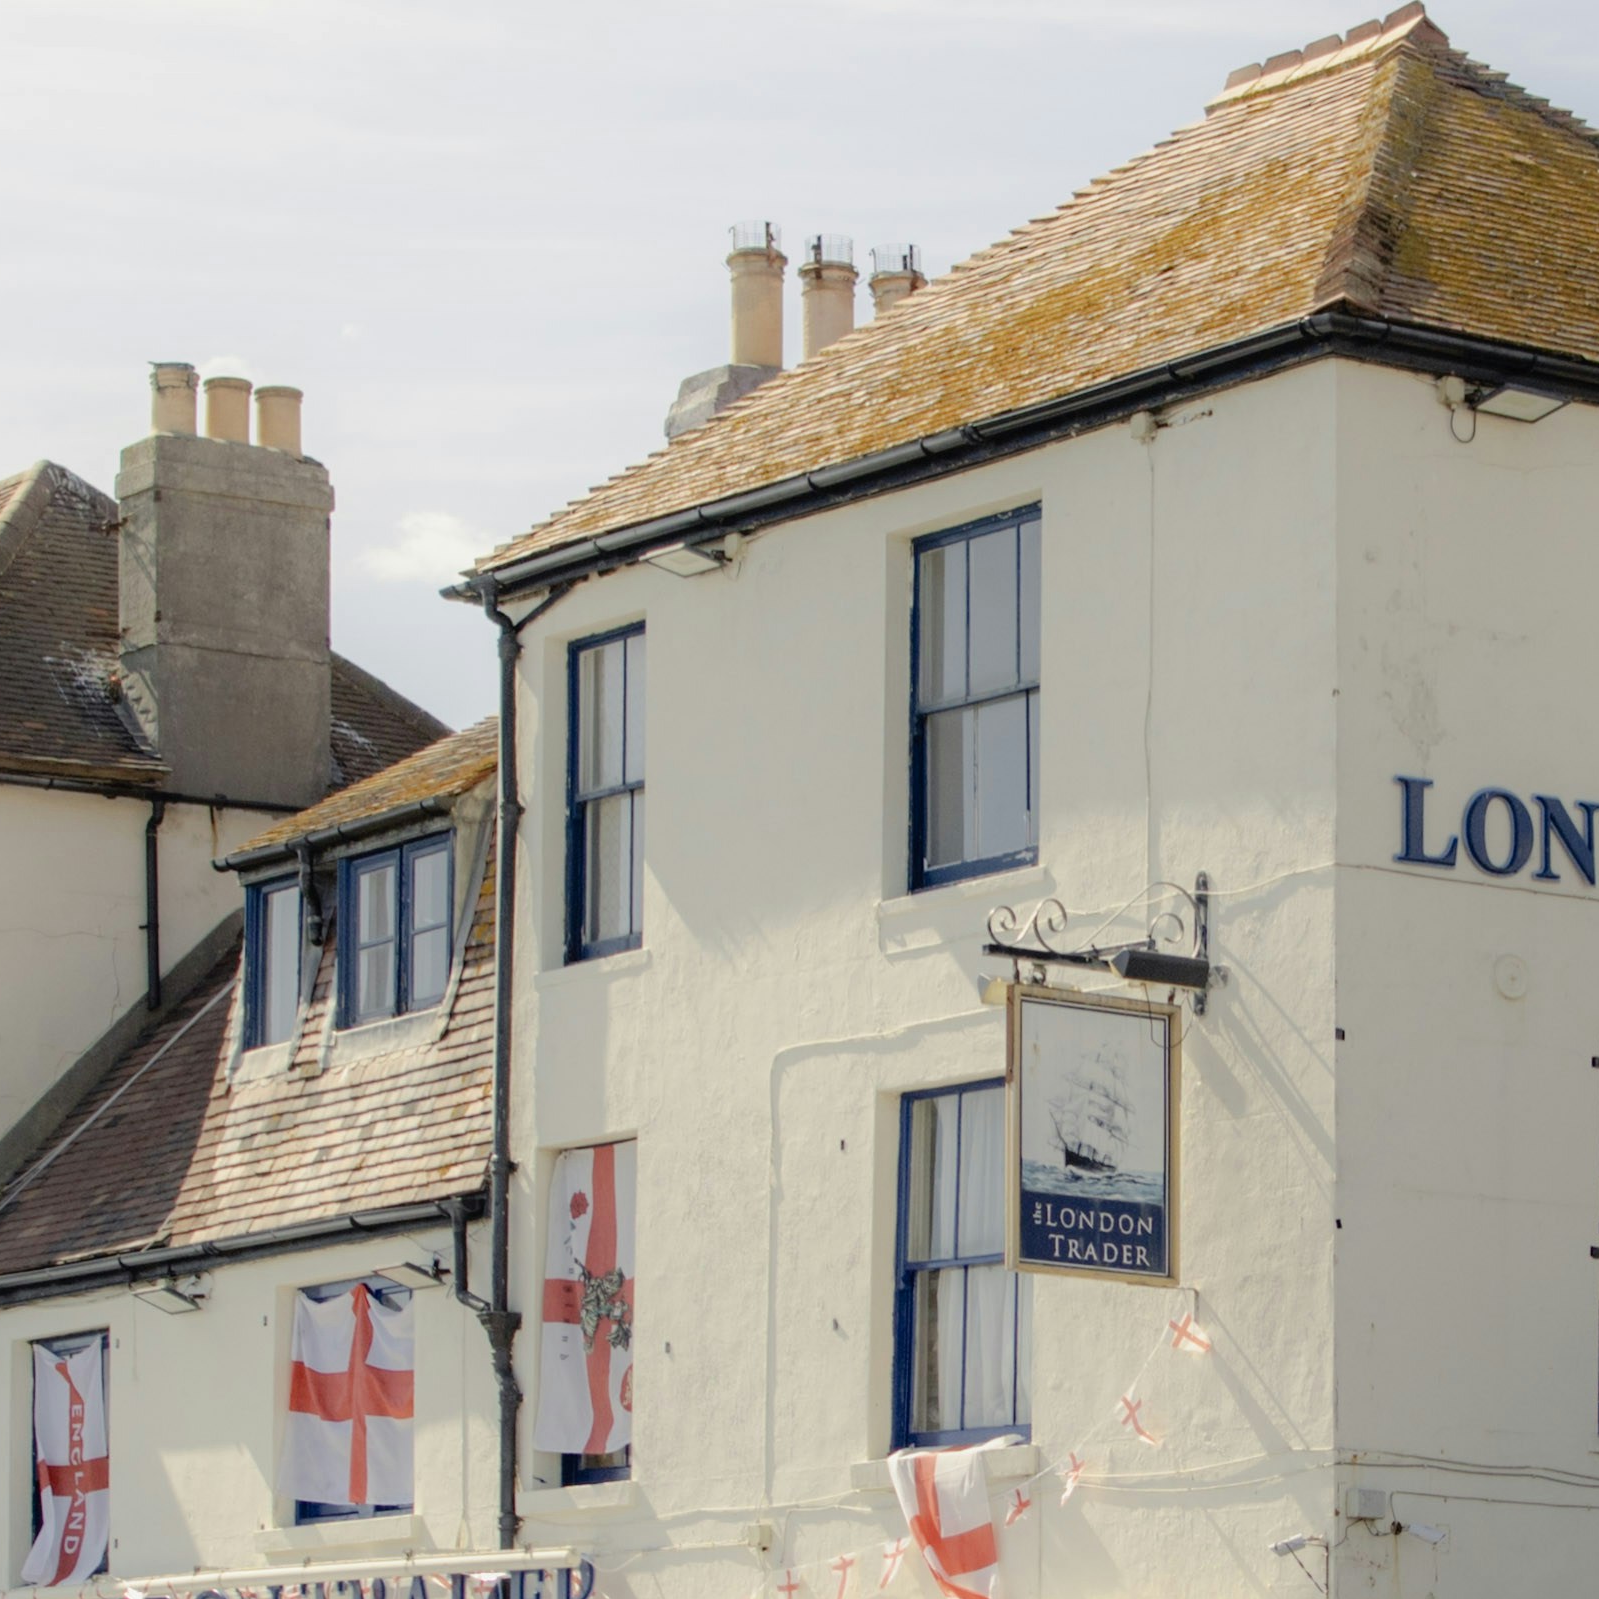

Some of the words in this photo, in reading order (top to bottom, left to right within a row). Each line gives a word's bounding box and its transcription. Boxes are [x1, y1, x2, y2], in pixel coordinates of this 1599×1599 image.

[1033, 1201, 1042, 1224] the
[1045, 1203, 1153, 1236] LONDON
[1048, 1233, 1150, 1267] TRADER
[64, 1404, 85, 1555] ENGLAND
